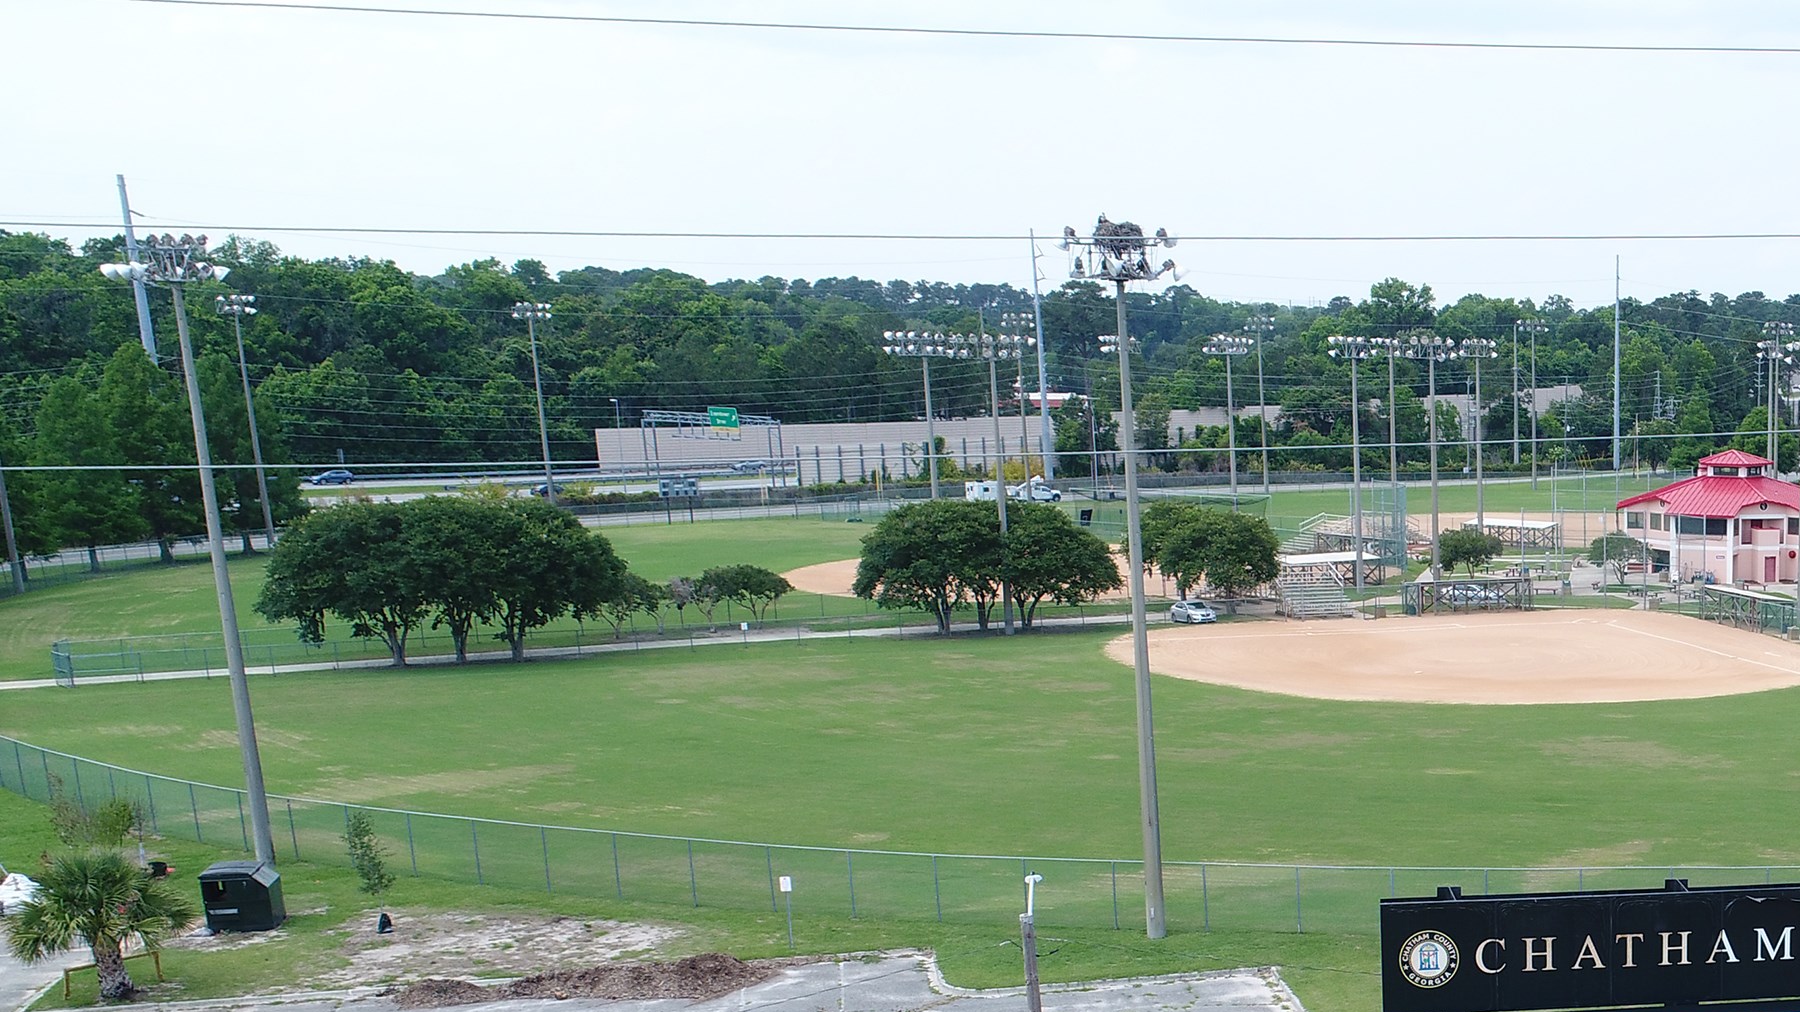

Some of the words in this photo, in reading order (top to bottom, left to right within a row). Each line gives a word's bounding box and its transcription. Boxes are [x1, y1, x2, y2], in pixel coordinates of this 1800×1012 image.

[1402, 933, 1430, 962] CHATHAM
[1433, 934, 1457, 960] COUNTY
[1475, 925, 1796, 974] CHATHAM
[1408, 971, 1451, 986] GEORGIA
